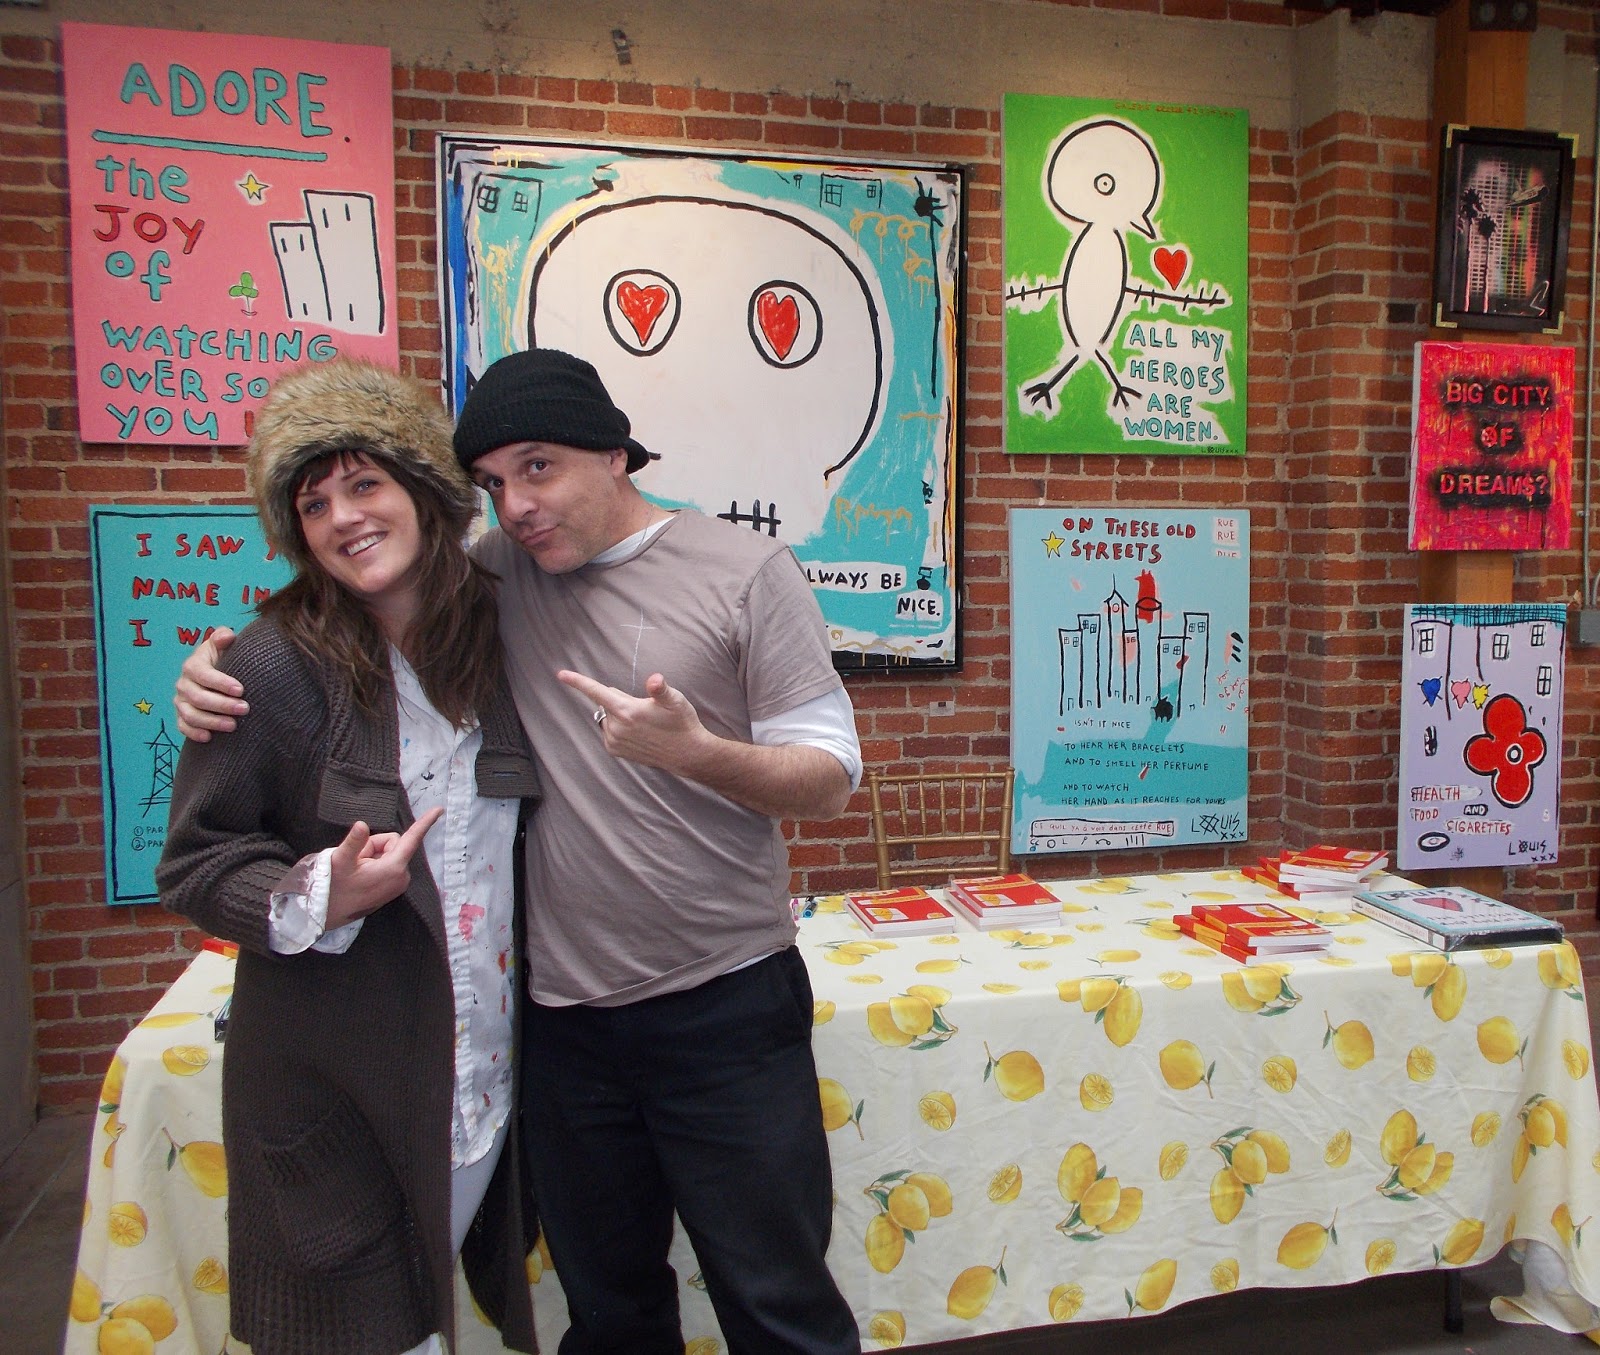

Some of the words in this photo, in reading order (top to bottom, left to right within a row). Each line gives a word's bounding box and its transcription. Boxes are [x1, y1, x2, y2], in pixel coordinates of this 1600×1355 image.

[120, 62, 333, 138] ADORE
[96, 154, 191, 204] the
[93, 204, 205, 254] JOY
[105, 249, 172, 302] of
[1130, 323, 1177, 348] ALL
[1192, 329, 1224, 362] MY
[1130, 359, 1225, 395] HEROES
[1447, 381, 1484, 404] BIG
[1493, 384, 1550, 407] CITY
[1147, 392, 1193, 419] ARE
[106, 403, 219, 441] YOU
[1481, 426, 1514, 448] OF
[1063, 517, 1093, 533] ON
[1105, 518, 1159, 537] THESE
[1166, 524, 1196, 538] OLD
[1217, 518, 1234, 527] RUE
[136, 533, 151, 557] I
[175, 534, 244, 560] SAW
[1217, 531, 1236, 541] RUE
[806, 568, 869, 590] LWAYS
[880, 572, 902, 590] BE
[132, 576, 221, 606] NAME
[897, 597, 941, 617] NICE.
[129, 619, 151, 647] I
[1111, 720, 1131, 729] NICE
[1064, 742, 1076, 752] TO
[1080, 741, 1103, 750] HEAR
[1108, 741, 1127, 751] HER
[1064, 757, 1085, 766] AND
[1089, 758, 1101, 767] TO
[1105, 759, 1136, 768] SMELL
[1140, 760, 1159, 770] HER
[1163, 760, 1209, 771] PERFUME
[1063, 784, 1079, 792] AND
[1081, 783, 1093, 792] TO
[1095, 784, 1129, 792] WATCH
[1414, 787, 1460, 800] HEALTH
[1061, 797, 1079, 806] HER
[1084, 798, 1108, 807] HAND
[1130, 797, 1137, 805] IT
[1142, 796, 1179, 805] REACHES
[1186, 797, 1201, 805] FOR
[1464, 806, 1486, 816] AND
[1414, 808, 1439, 821] FOOD
